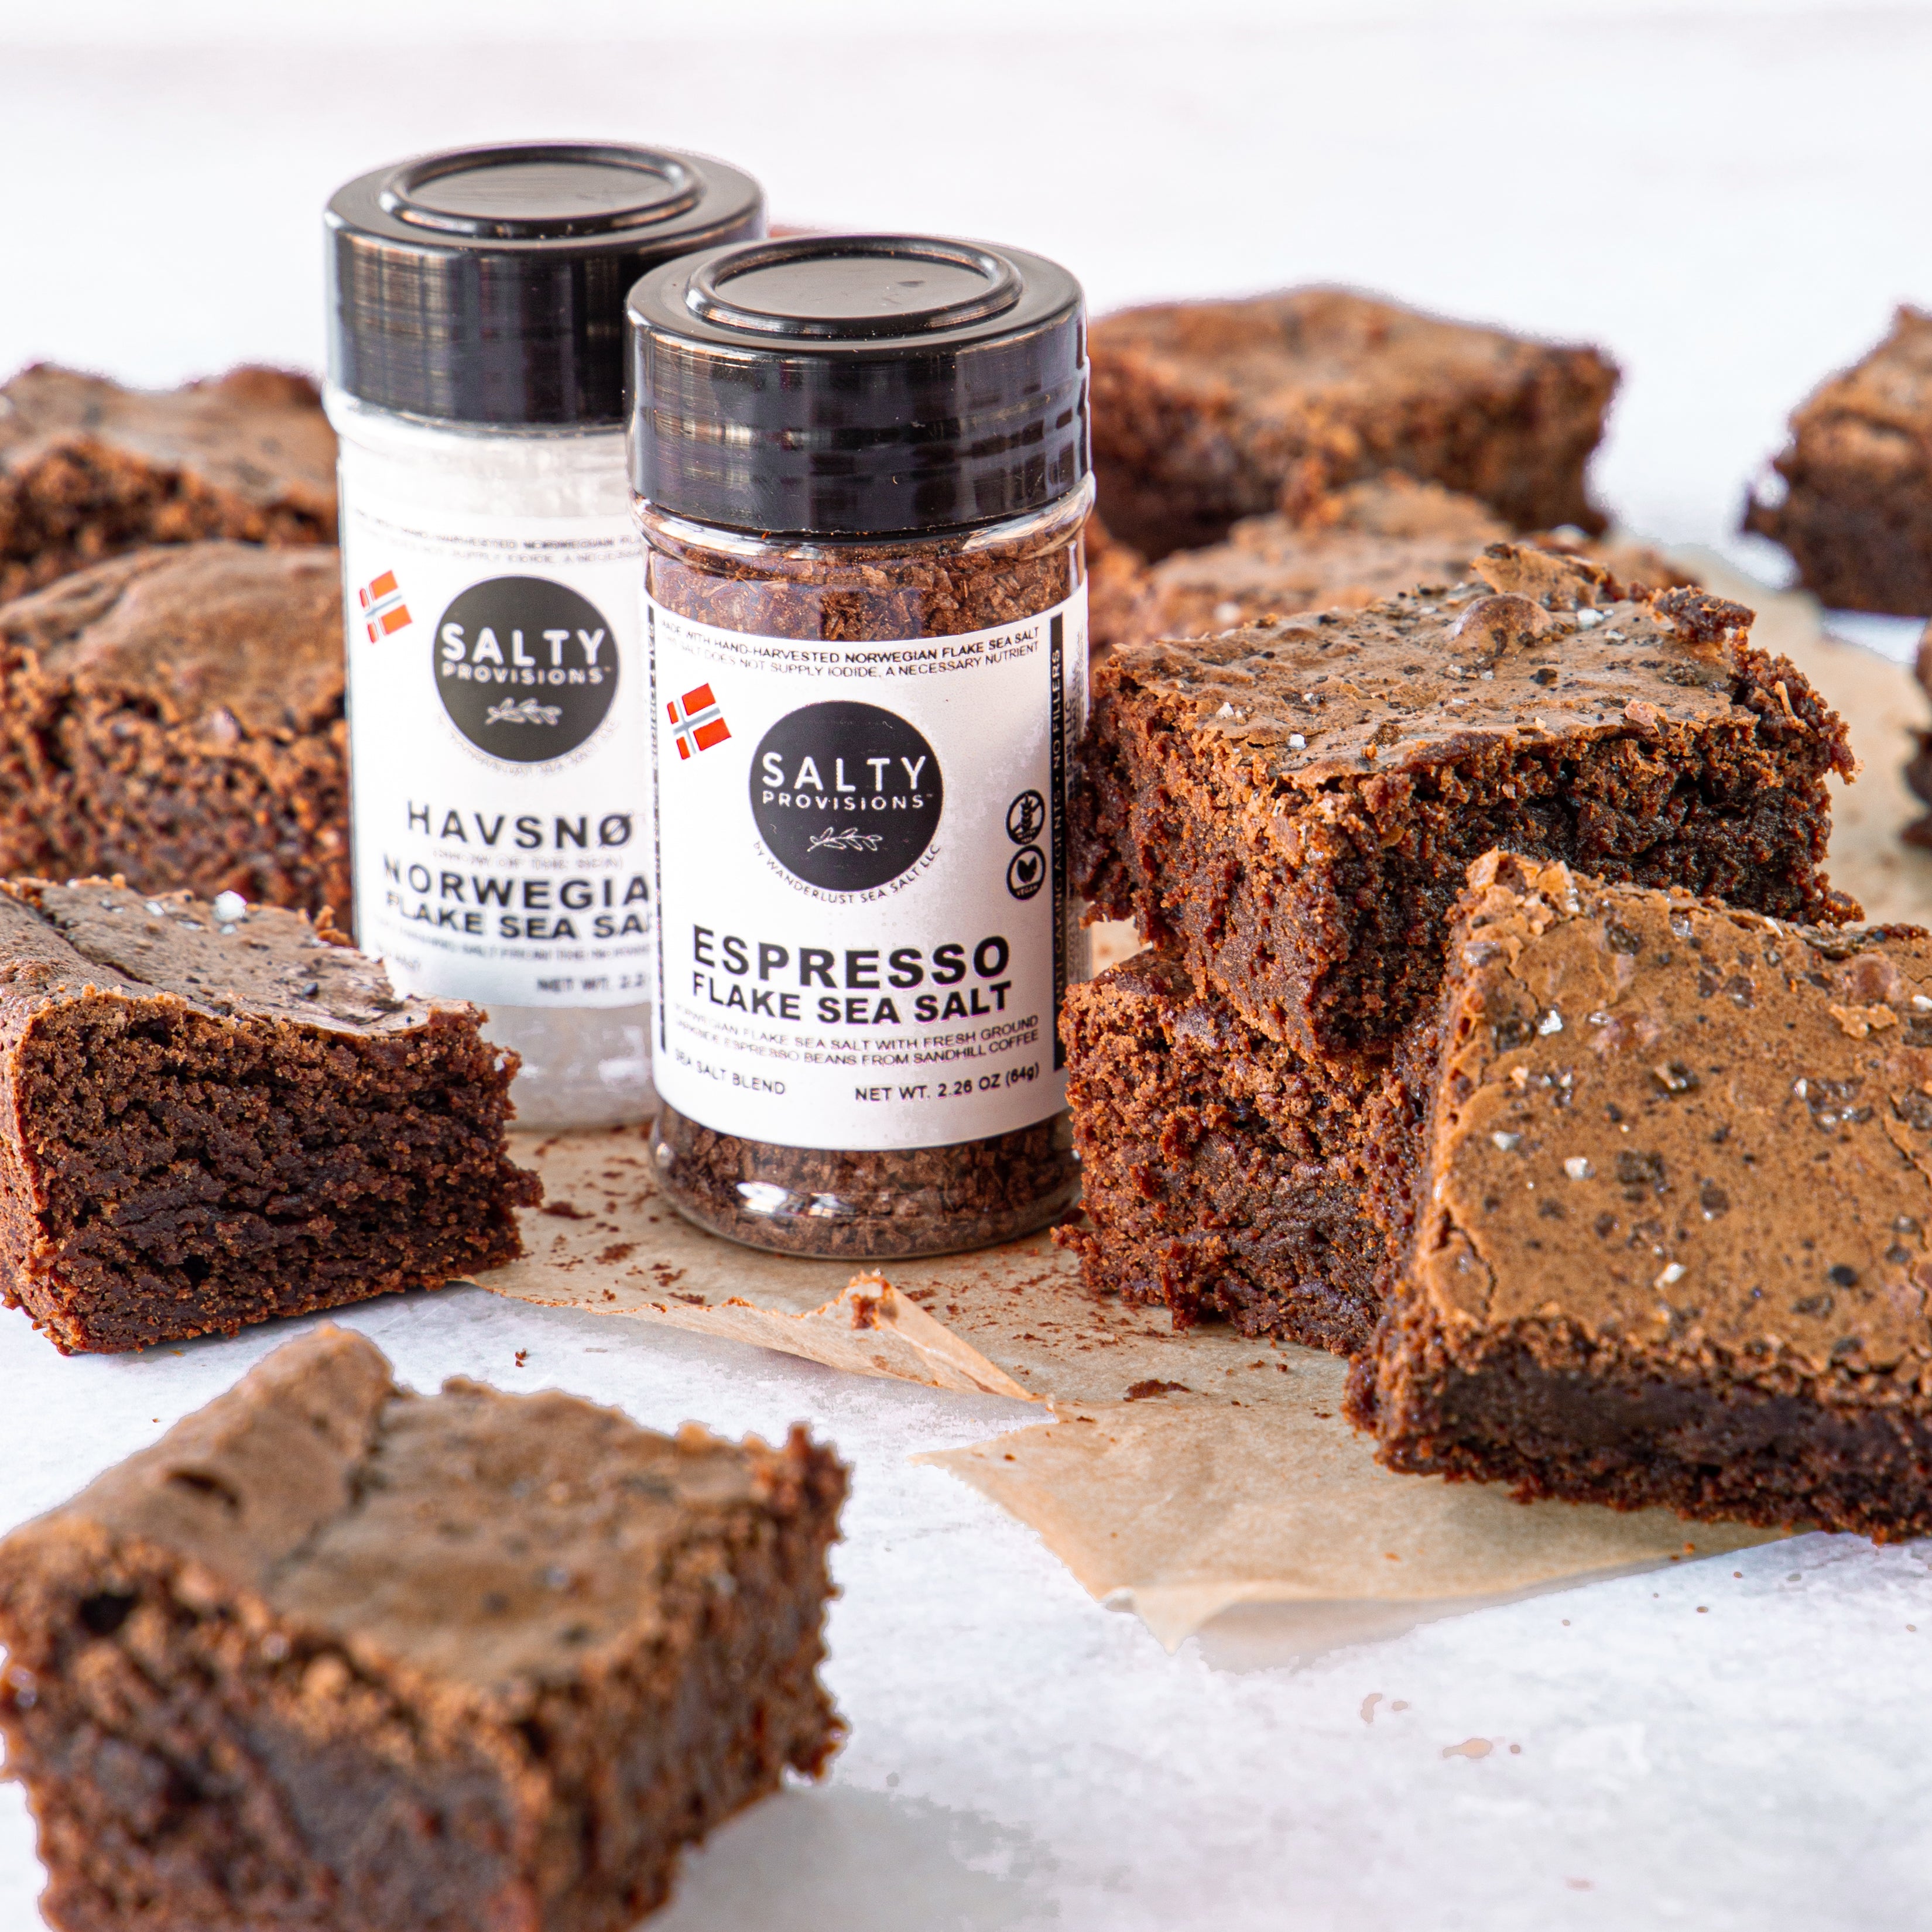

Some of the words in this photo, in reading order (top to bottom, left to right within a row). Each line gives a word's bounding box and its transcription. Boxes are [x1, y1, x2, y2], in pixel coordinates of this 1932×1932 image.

[441, 622, 605, 666] SALTY
[715, 639, 839, 663] HAND-HARVESTED
[845, 649, 937, 663] NORWEGIAN
[942, 642, 984, 658] FLAKE
[988, 636, 1012, 649] SEA
[1015, 626, 1039, 644] SALT
[740, 658, 765, 670] NOT
[770, 662, 823, 676] SUPPLY
[886, 666, 895, 676] A
[899, 656, 982, 676] NECESSARY
[985, 641, 1039, 666] NUTRIENT
[441, 661, 604, 686] PROVISIONS
[1052, 649, 1061, 733] FILLERS
[762, 752, 926, 792] SALTY
[1053, 741, 1061, 769] NO
[763, 790, 924, 811] PROVISIONS
[407, 800, 633, 850] HAVSNØ
[767, 858, 854, 904] WANDERLUST
[861, 889, 885, 903] SEA
[889, 867, 921, 893] SALT
[920, 844, 941, 868] LLC
[387, 890, 484, 936] FLAKE
[499, 913, 577, 939] SEA
[593, 911, 650, 938] SA
[693, 924, 1009, 989] ESPRESSO
[693, 971, 801, 1020] FLAKE
[817, 996, 901, 1024] SEA
[914, 981, 1011, 1024] SALT
[744, 1027, 789, 1046] FLAKE
[795, 1036, 826, 1049] SEA
[830, 1039, 869, 1051] SALT
[875, 1039, 917, 1051] WITH
[923, 1032, 976, 1048] FRESH
[980, 1015, 1039, 1041] GROUND
[804, 1051, 857, 1066] BEANS
[862, 1055, 909, 1066] FROM
[913, 1044, 986, 1064] SANDHILL
[988, 1029, 1039, 1053] COFFEE
[697, 1060, 726, 1081] SALT
[732, 1073, 785, 1095] BLEND
[855, 1087, 892, 1102] NET
[899, 1085, 931, 1101] WT.
[937, 1079, 972, 1099] 2.26
[978, 1073, 1001, 1091] OZ
[1005, 1061, 1040, 1088] (64g)
